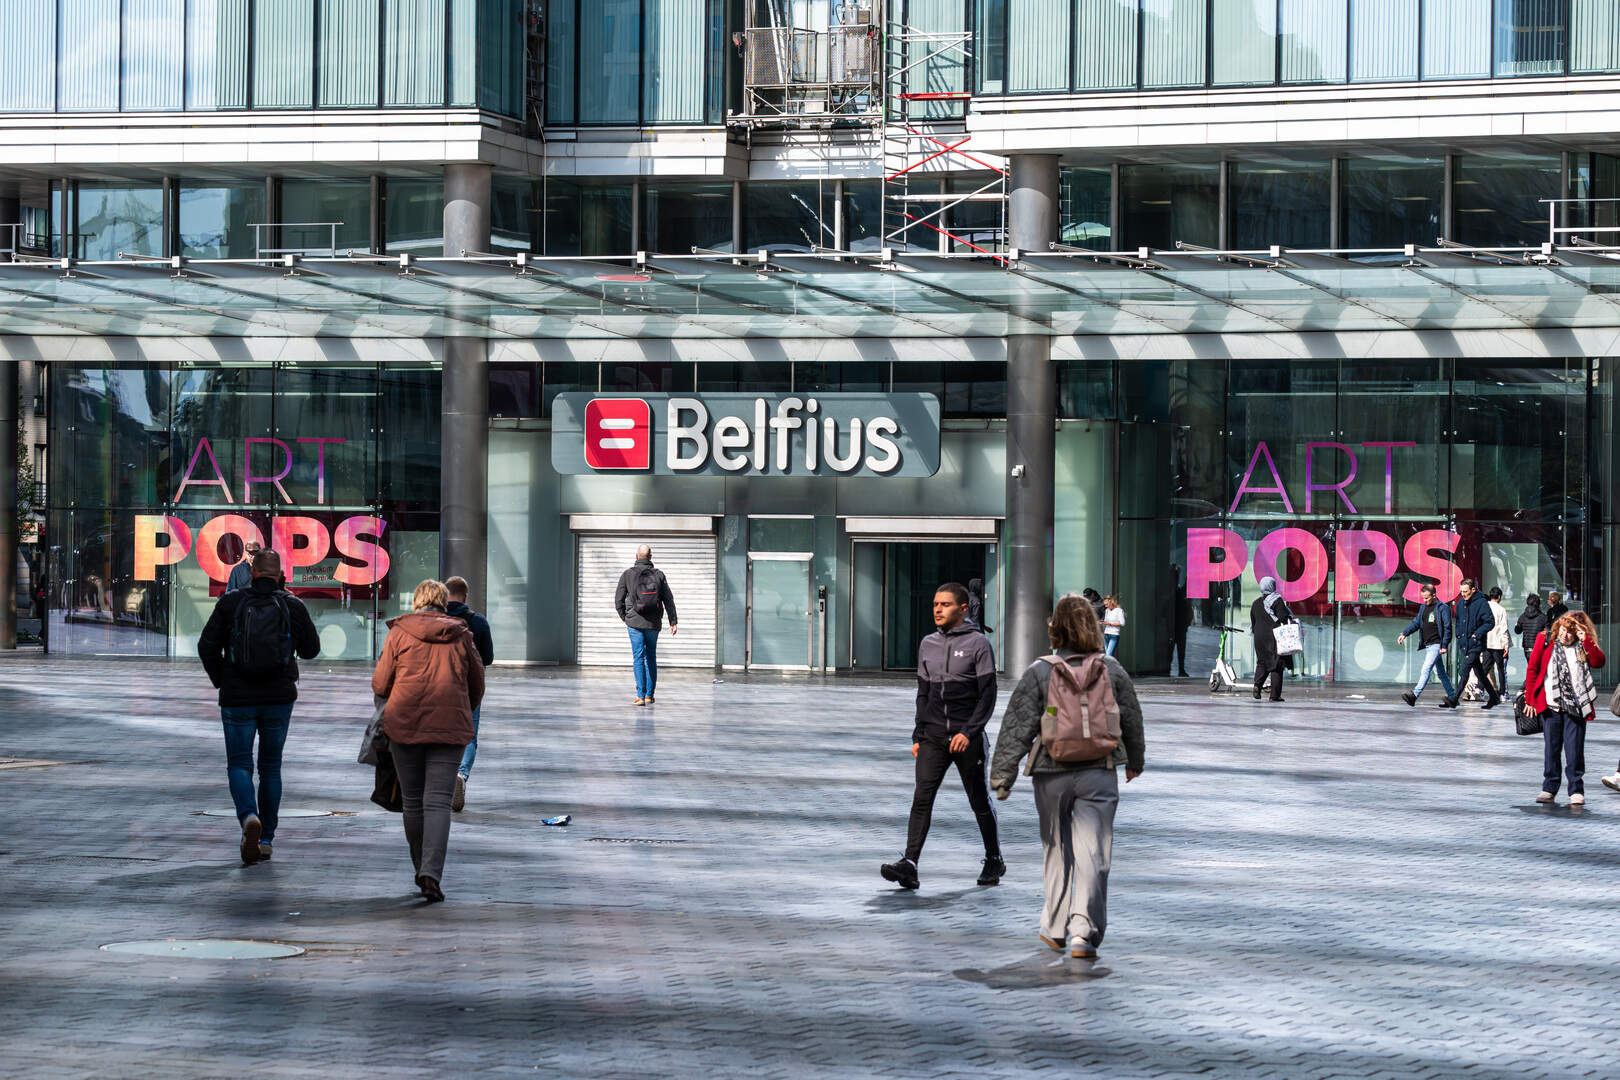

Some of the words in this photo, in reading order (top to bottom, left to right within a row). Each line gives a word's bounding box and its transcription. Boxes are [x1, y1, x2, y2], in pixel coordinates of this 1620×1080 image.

[173, 437, 346, 504] ART
[667, 397, 901, 473] Belfius
[1229, 441, 1416, 514] ART
[134, 514, 390, 585] POPS
[1186, 528, 1464, 603] POPS
